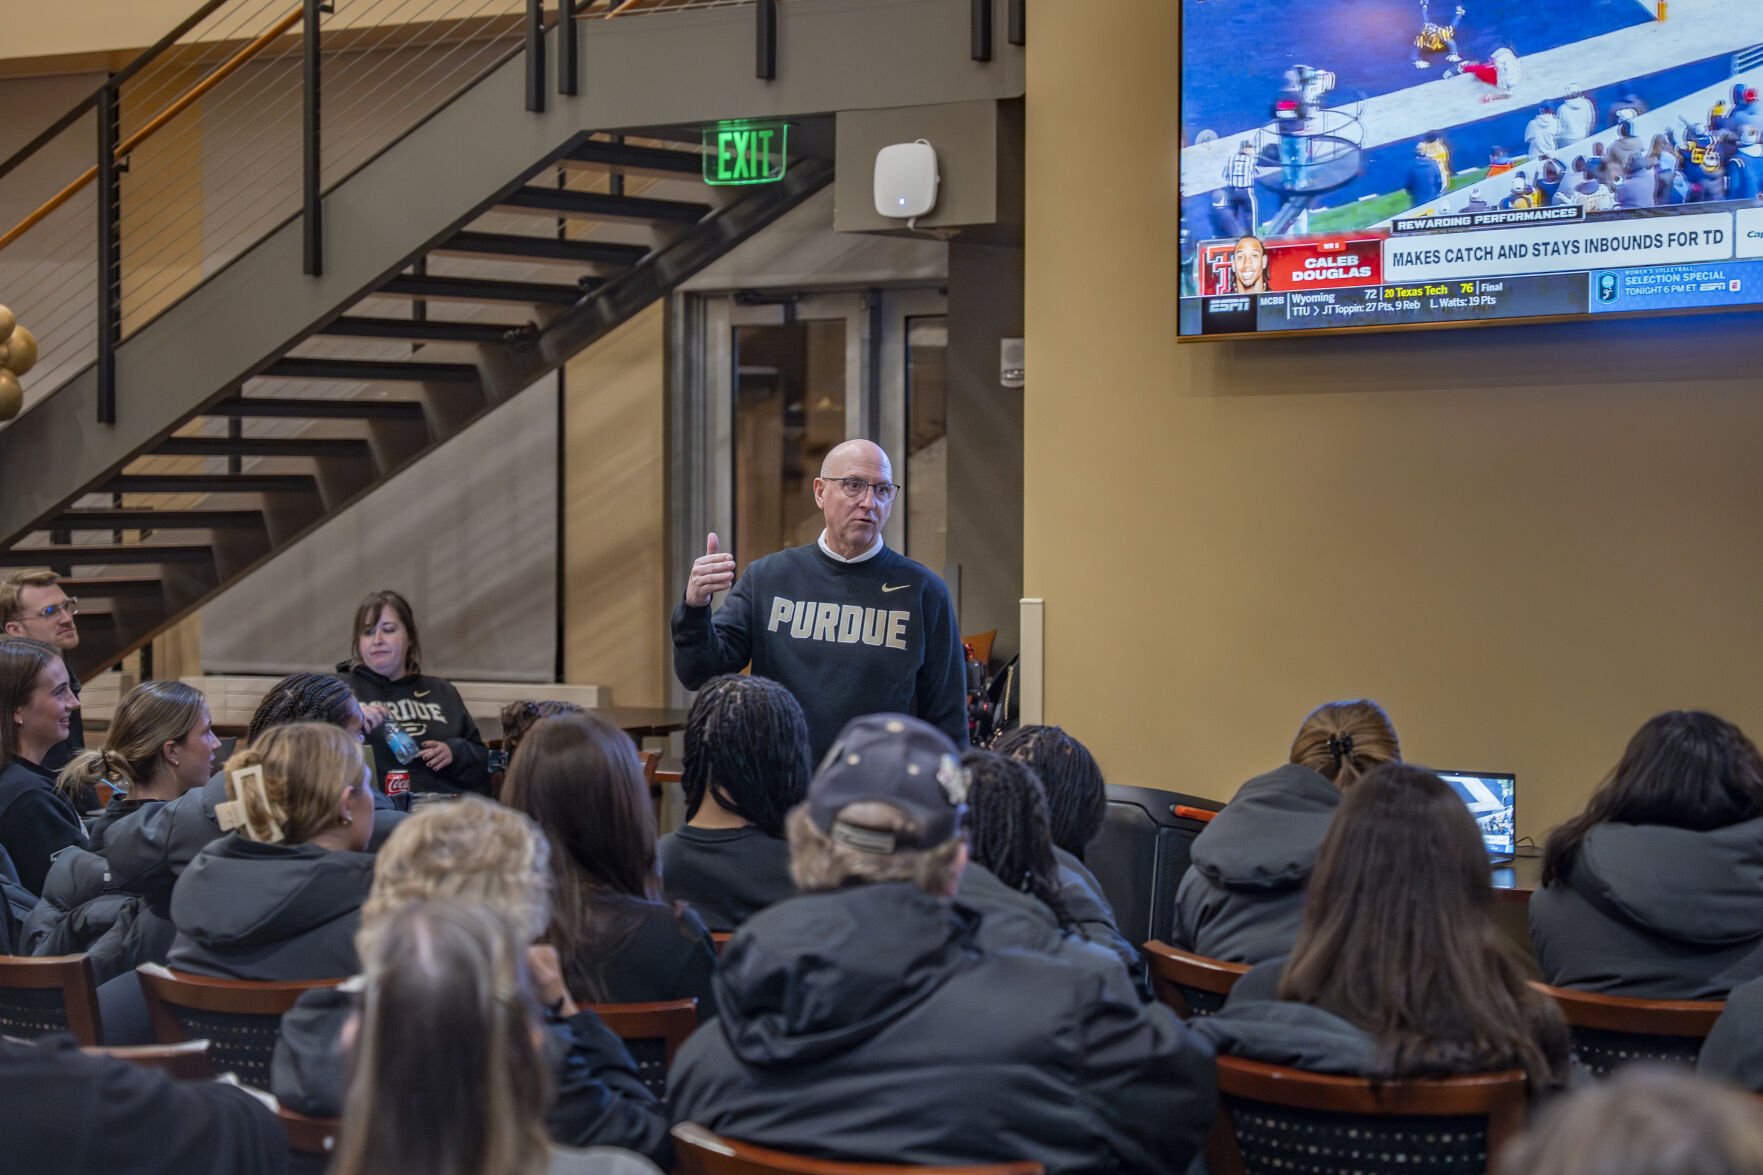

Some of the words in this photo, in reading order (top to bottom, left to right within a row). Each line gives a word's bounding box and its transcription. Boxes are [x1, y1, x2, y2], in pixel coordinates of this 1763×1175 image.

[718, 130, 774, 179] EXIT
[1397, 216, 1472, 231] REWARDING
[1474, 208, 1578, 225] PERFORMANCES
[1392, 249, 1441, 267] MAKES
[1444, 245, 1494, 263] CATCH
[1497, 243, 1528, 260] AND
[1532, 239, 1581, 258] STAYS
[1585, 233, 1663, 254] INBOUNDS
[1668, 231, 1699, 248] FOR
[1703, 229, 1724, 245] TD
[1304, 255, 1359, 269] CALEB
[1292, 266, 1372, 282] DOUGLAS
[1625, 274, 1681, 286] SELECTION
[1683, 270, 1726, 282] SPECIAL
[1291, 292, 1336, 306] Wyoming
[1364, 288, 1378, 300] 72
[1384, 288, 1395, 299] 20
[1395, 287, 1424, 298] Texas
[1424, 284, 1448, 296] Tech
[1460, 282, 1474, 294] 76
[1481, 281, 1503, 292] Final
[1625, 285, 1662, 296] TONIGHT
[1663, 285, 1670, 294] 6
[1671, 284, 1685, 293] PM
[1686, 283, 1697, 292] ET
[1209, 297, 1251, 313] ESPN
[1260, 296, 1285, 306] MCBB
[1292, 306, 1311, 316] TTU
[1322, 305, 1334, 315] JT
[1334, 303, 1365, 316] Toppin:
[1366, 302, 1377, 312] 27
[1395, 300, 1403, 311] 9
[1403, 299, 1421, 310] Reb
[1468, 296, 1480, 306] 19
[1481, 295, 1497, 305] Pts
[768, 596, 911, 650] PURDUE
